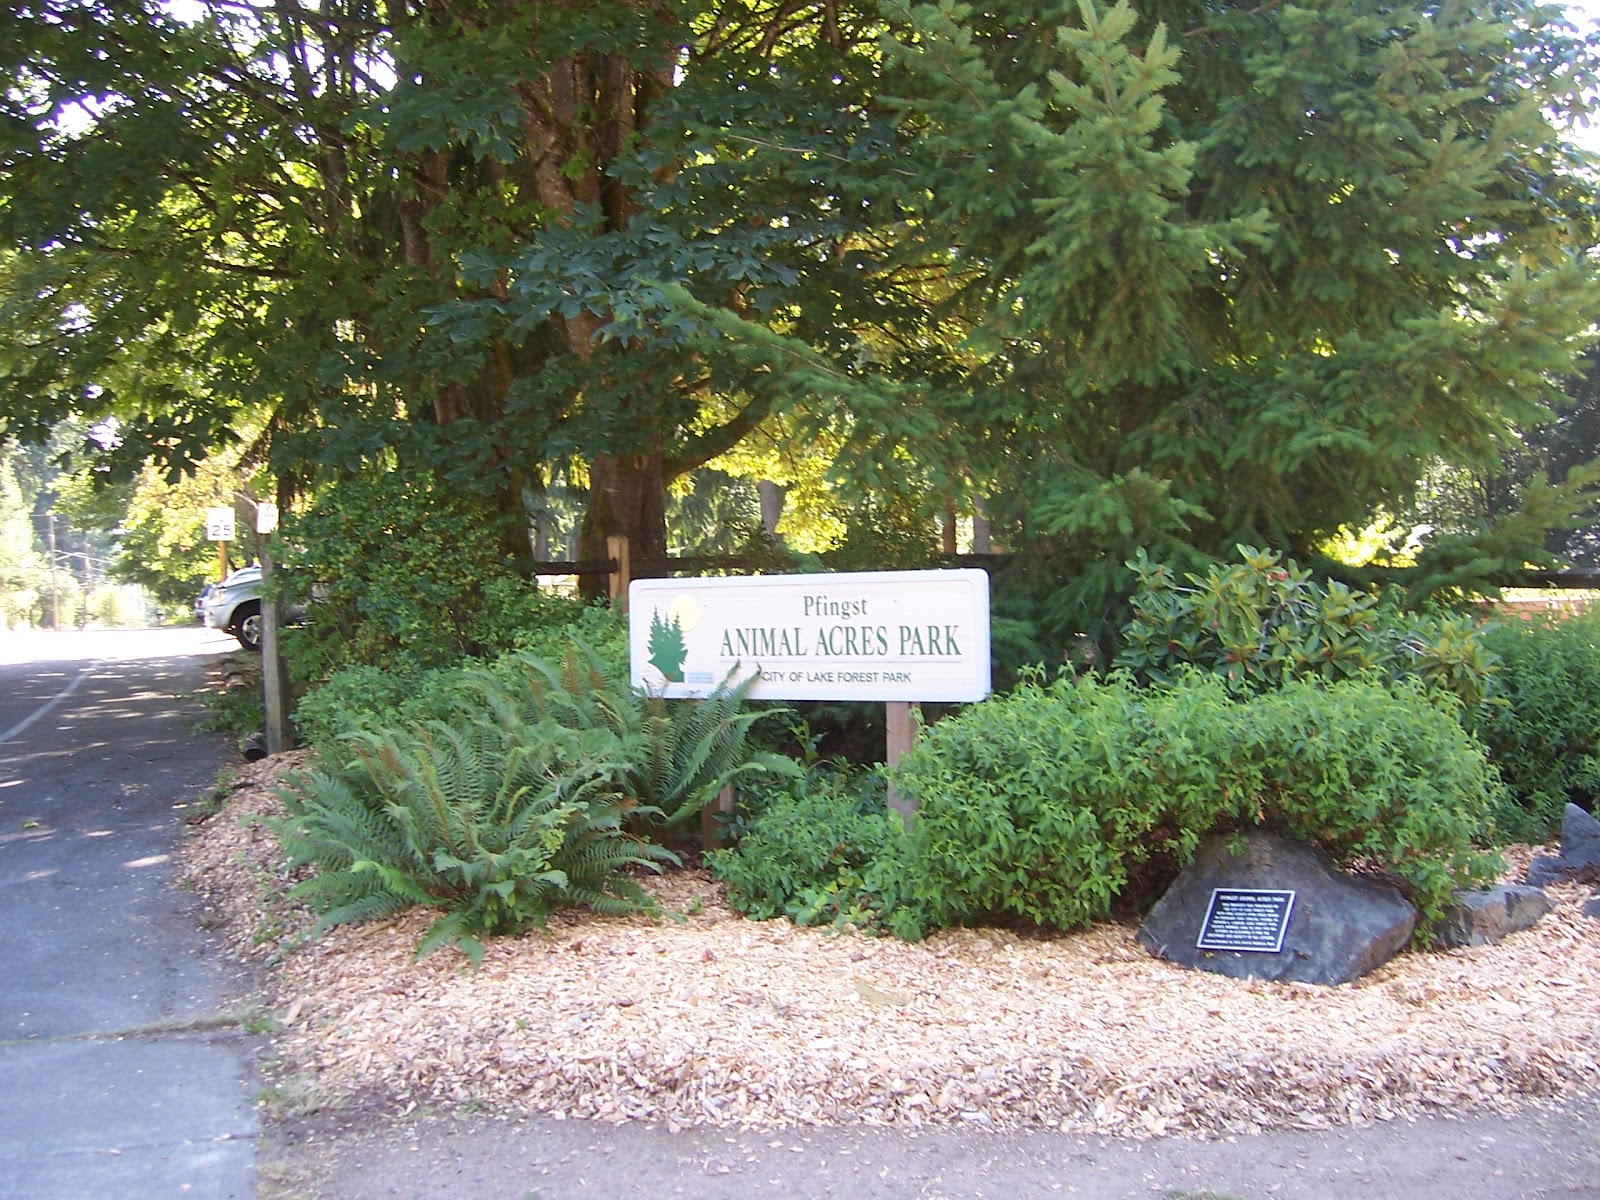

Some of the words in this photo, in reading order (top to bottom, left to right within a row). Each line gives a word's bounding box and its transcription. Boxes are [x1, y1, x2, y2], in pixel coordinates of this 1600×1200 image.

[212, 524, 232, 537] 25
[803, 595, 868, 619] Pfingst
[720, 628, 808, 657] ANIMAL
[815, 626, 889, 656] ACRES
[899, 625, 962, 656] PARK
[762, 671, 786, 682] CITY
[789, 671, 804, 682] OF
[806, 671, 835, 682] LAKE
[837, 671, 880, 682] FOREST
[883, 671, 912, 682] PARK
